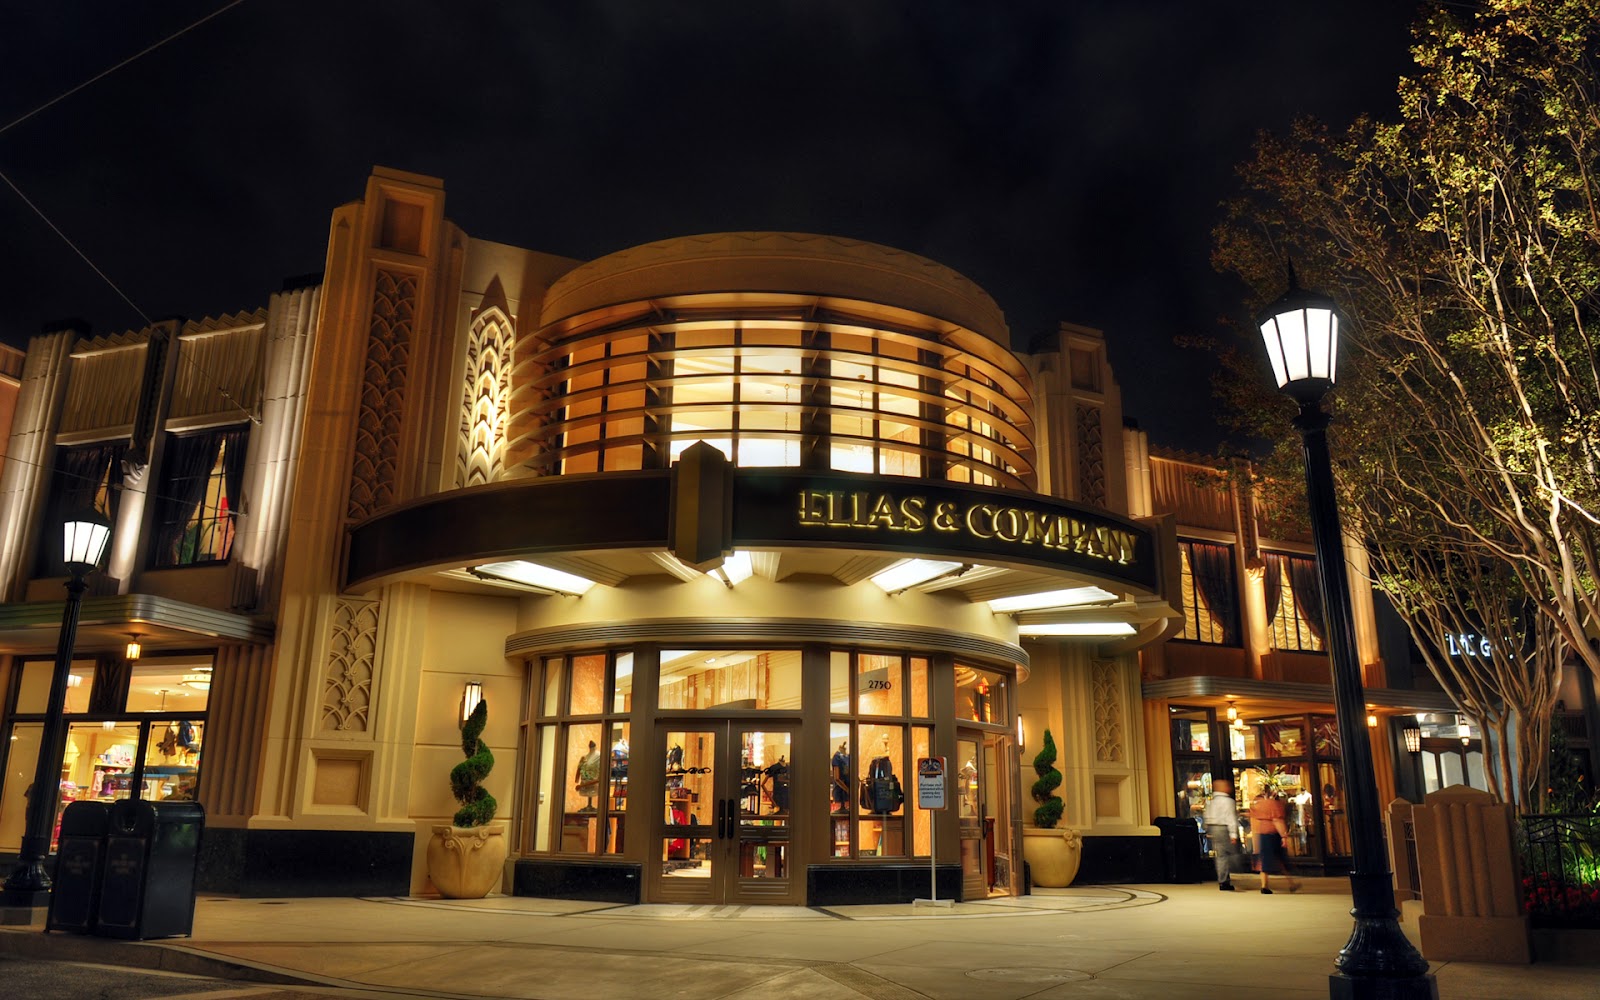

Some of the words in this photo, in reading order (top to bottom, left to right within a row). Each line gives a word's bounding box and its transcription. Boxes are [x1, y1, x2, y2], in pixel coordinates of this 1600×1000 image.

[799, 489, 926, 532] ELIAS
[934, 501, 962, 531] &
[966, 502, 1138, 565] COMPANY
[868, 680, 892, 690] 2750
